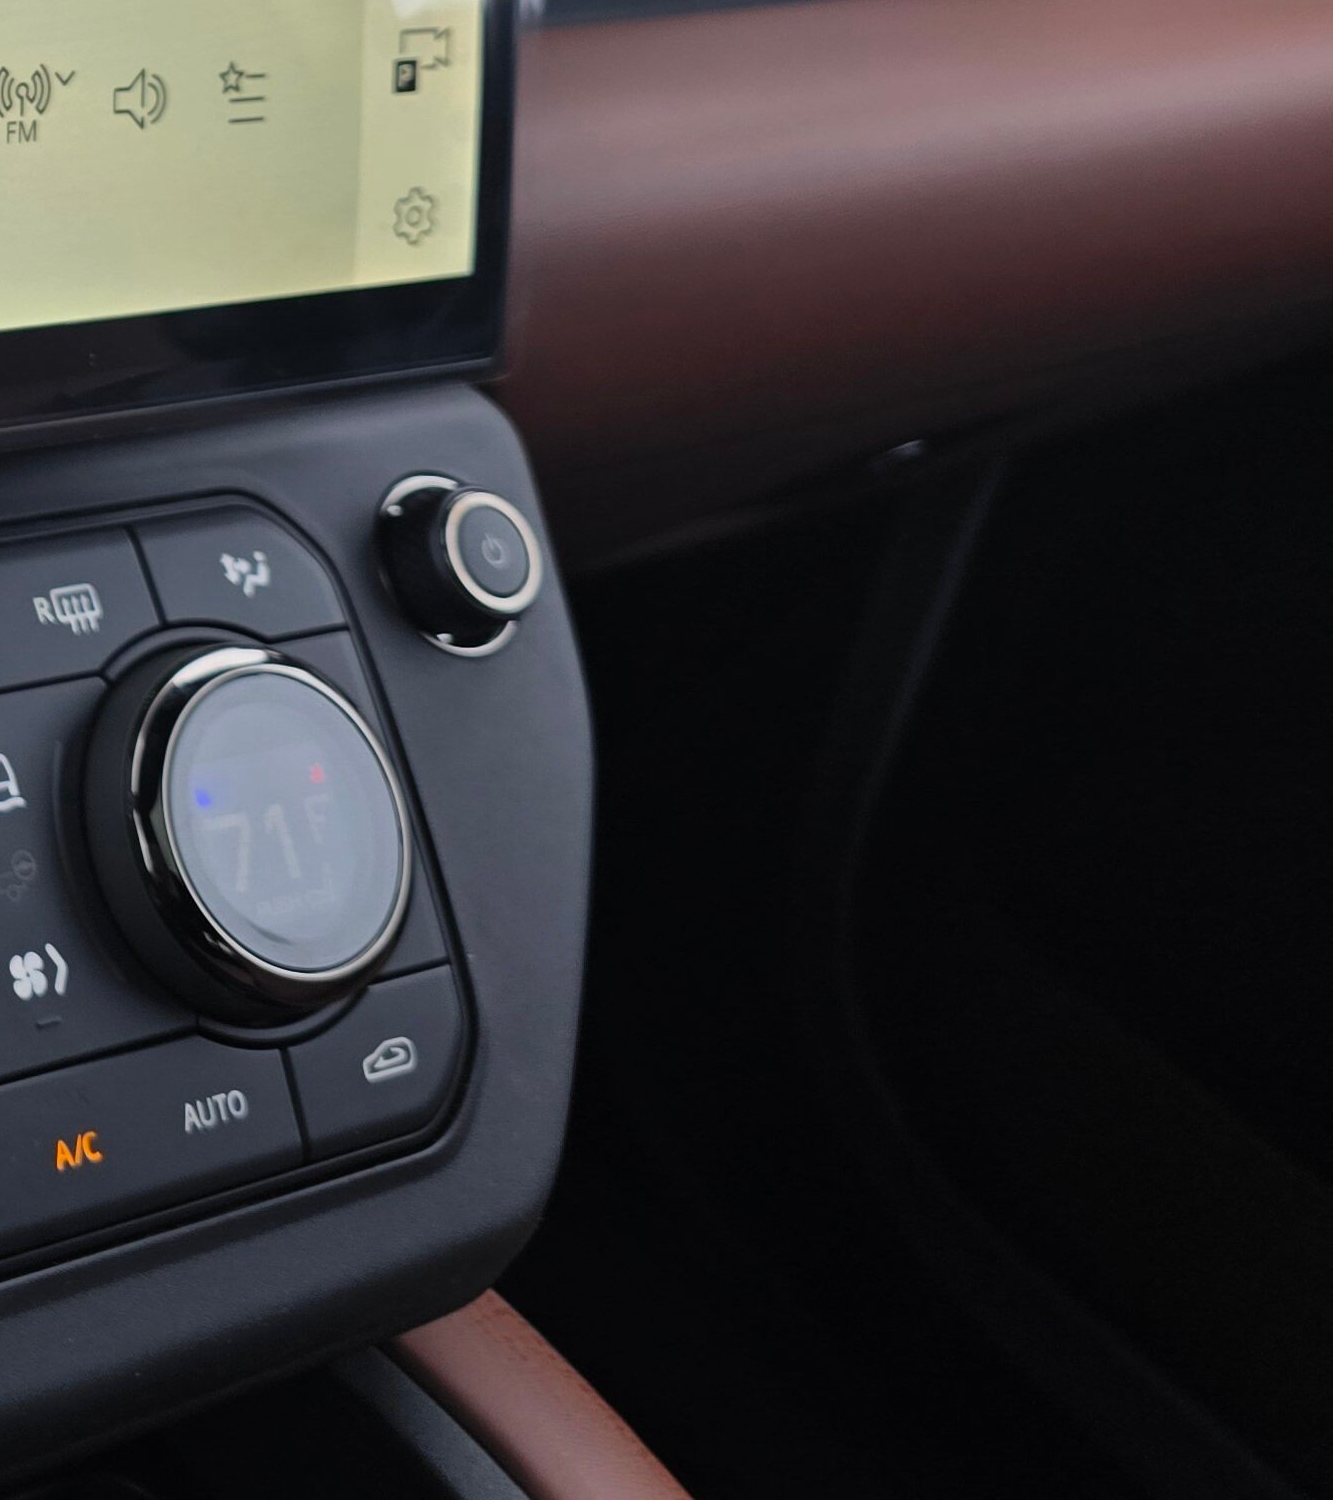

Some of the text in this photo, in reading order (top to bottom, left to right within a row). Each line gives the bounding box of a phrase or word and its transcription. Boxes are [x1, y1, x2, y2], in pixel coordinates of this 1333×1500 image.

[6, 120, 37, 144] FM
[33, 596, 56, 625] R
[204, 803, 301, 893] 71
[180, 1089, 250, 1134] AUTO
[55, 1130, 103, 1172] A/C
